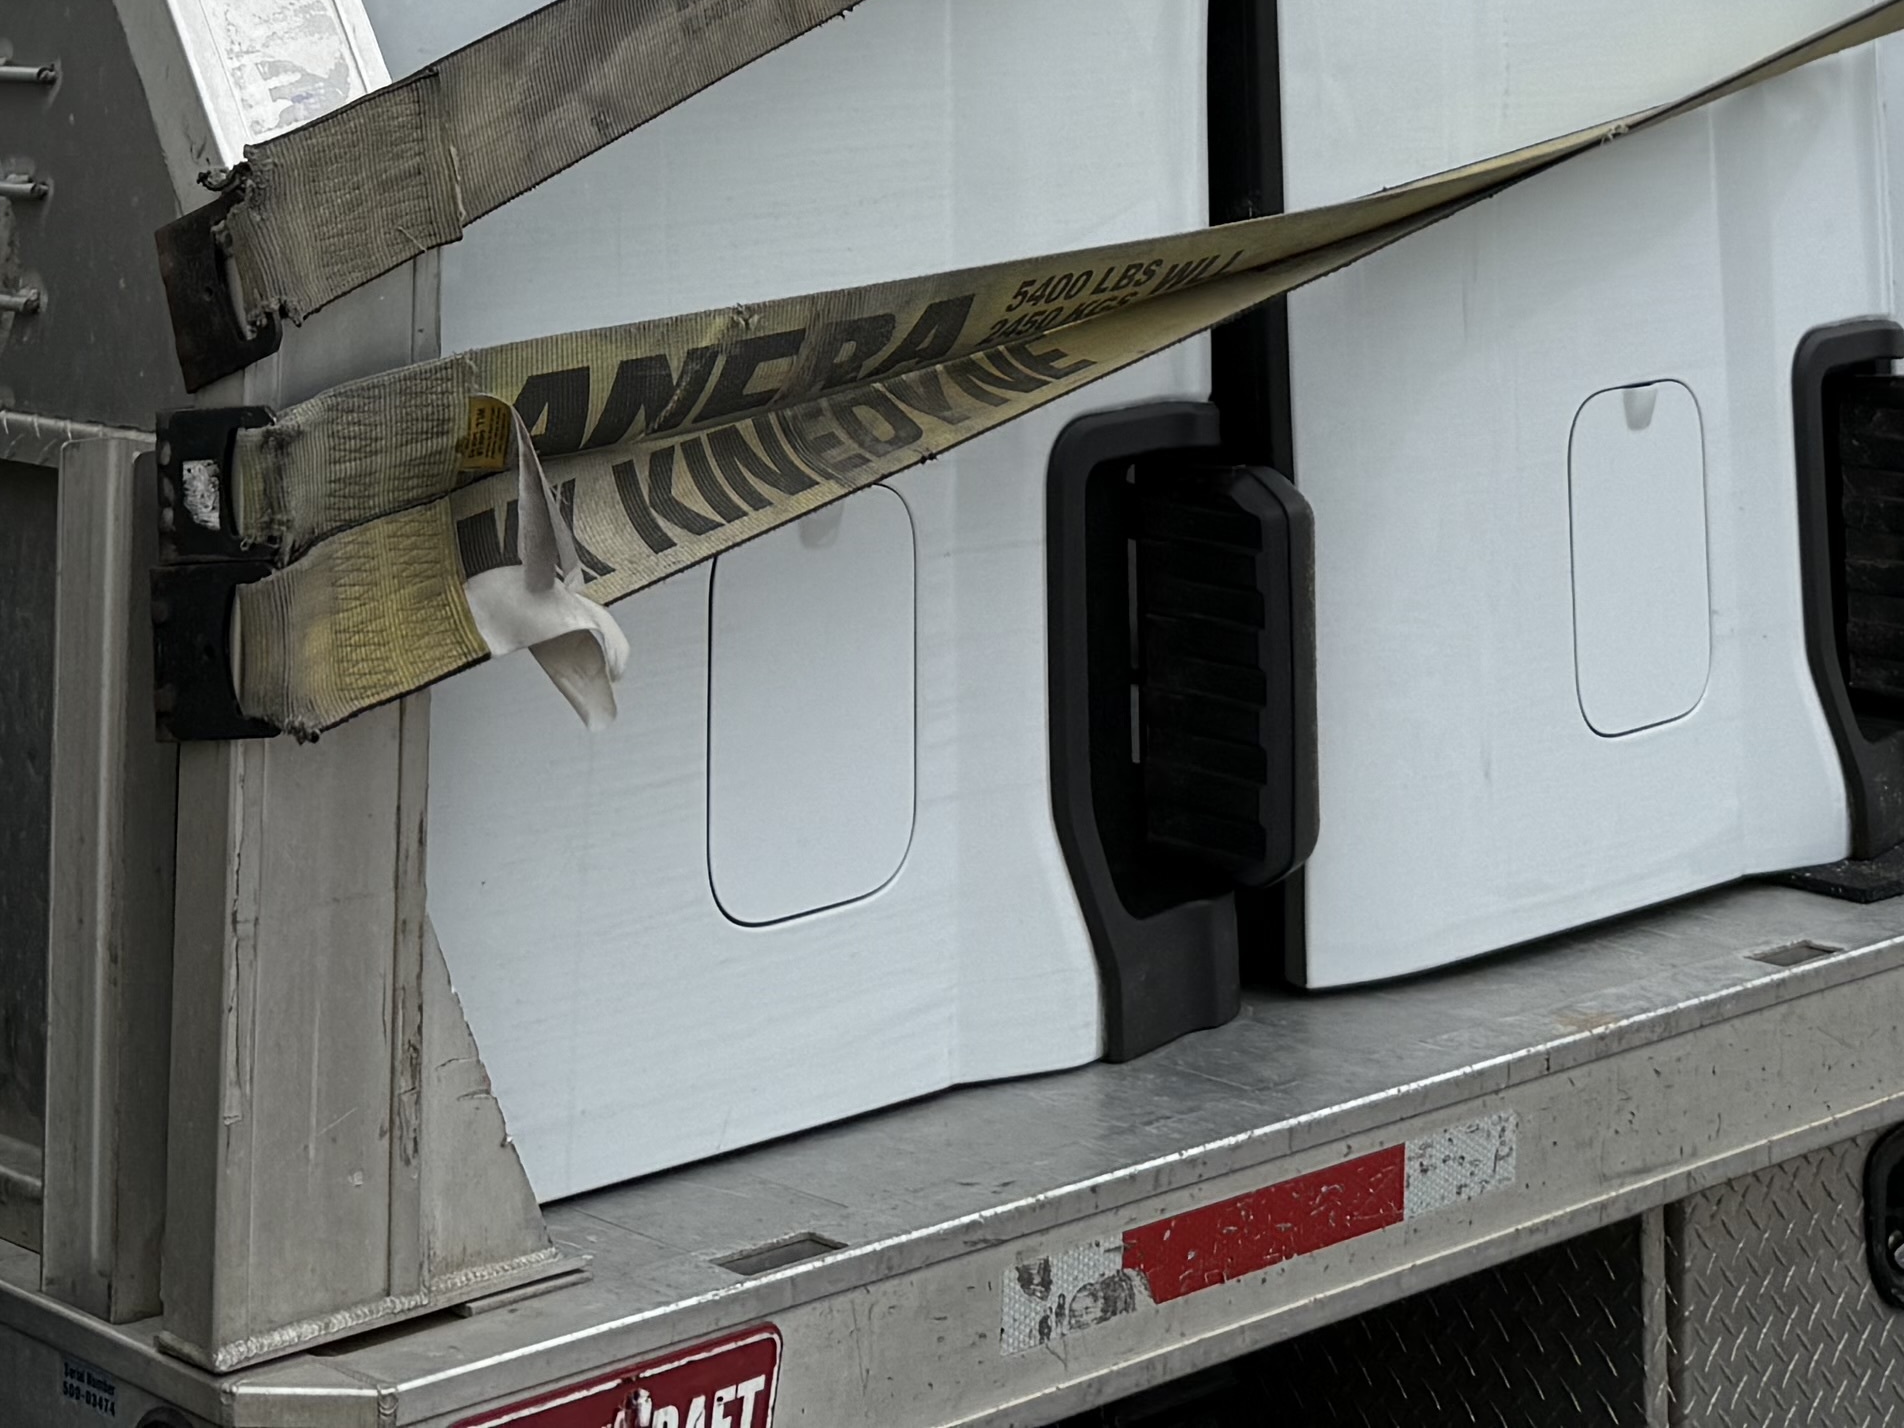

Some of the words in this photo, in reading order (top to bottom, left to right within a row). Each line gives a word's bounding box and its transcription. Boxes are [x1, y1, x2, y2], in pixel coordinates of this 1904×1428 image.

[1006, 269, 1093, 313] 5400
[1091, 258, 1163, 296] LBS
[976, 306, 1063, 346] 2450
[517, 294, 975, 456] ANCRA
